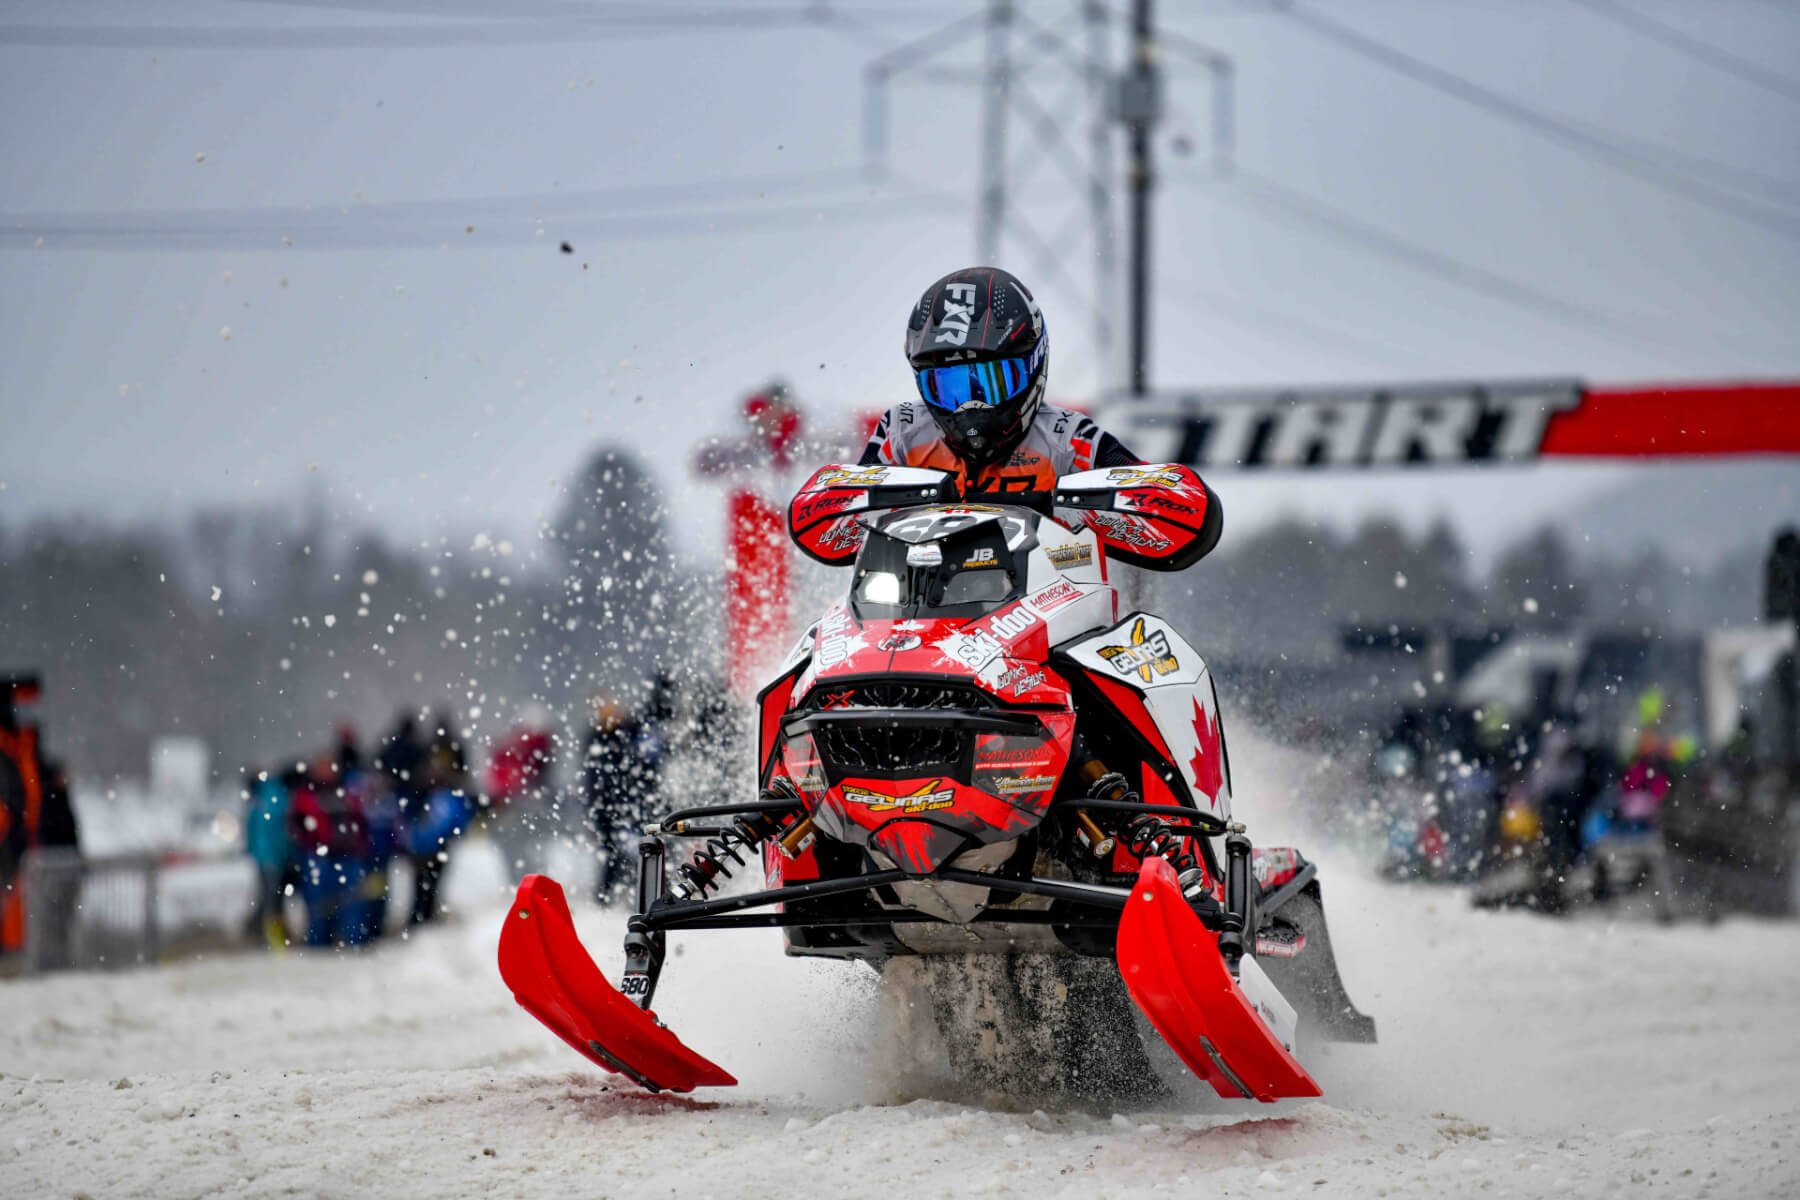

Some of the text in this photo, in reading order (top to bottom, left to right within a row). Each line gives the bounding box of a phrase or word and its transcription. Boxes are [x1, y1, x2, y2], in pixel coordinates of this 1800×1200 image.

[935, 283, 976, 345] FXR
[1098, 391, 1580, 463] START
[966, 548, 994, 562] JB
[844, 788, 956, 807] GELINAS
